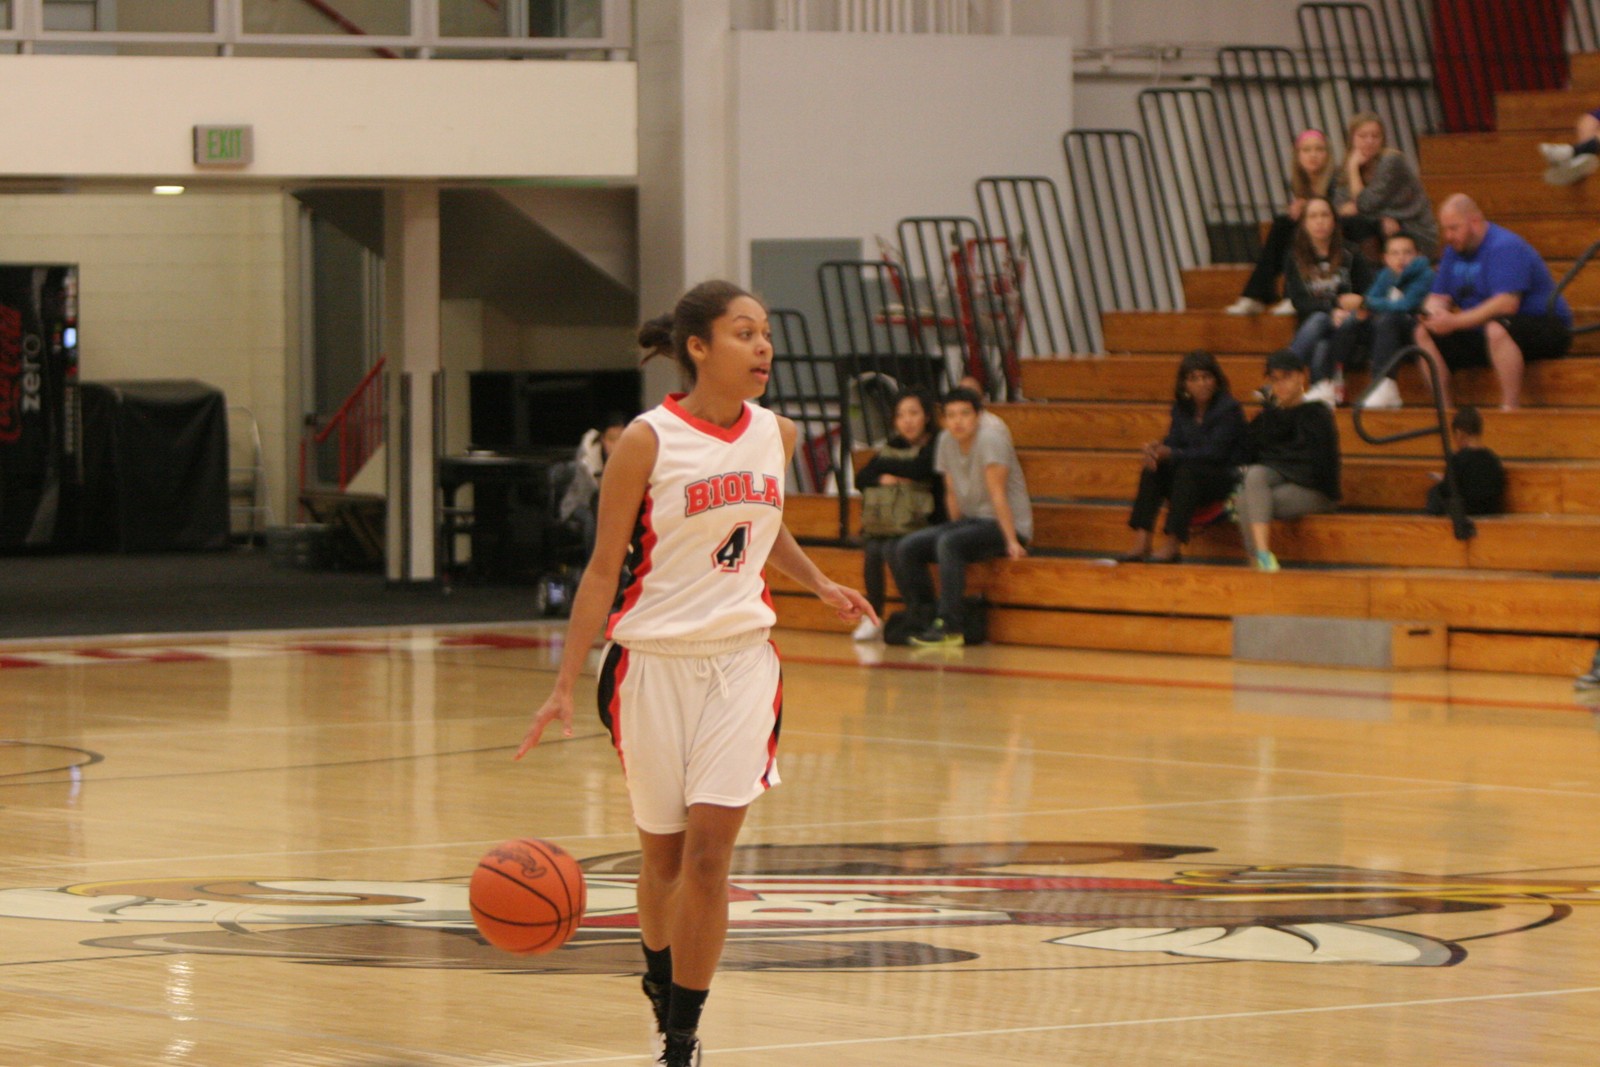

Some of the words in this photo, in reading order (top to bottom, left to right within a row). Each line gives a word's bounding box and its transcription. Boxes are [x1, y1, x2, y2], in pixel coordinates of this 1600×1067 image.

[207, 128, 243, 160] EXIT
[23, 333, 41, 412] zero
[685, 471, 782, 518] BIOLA
[711, 520, 752, 573] 4
